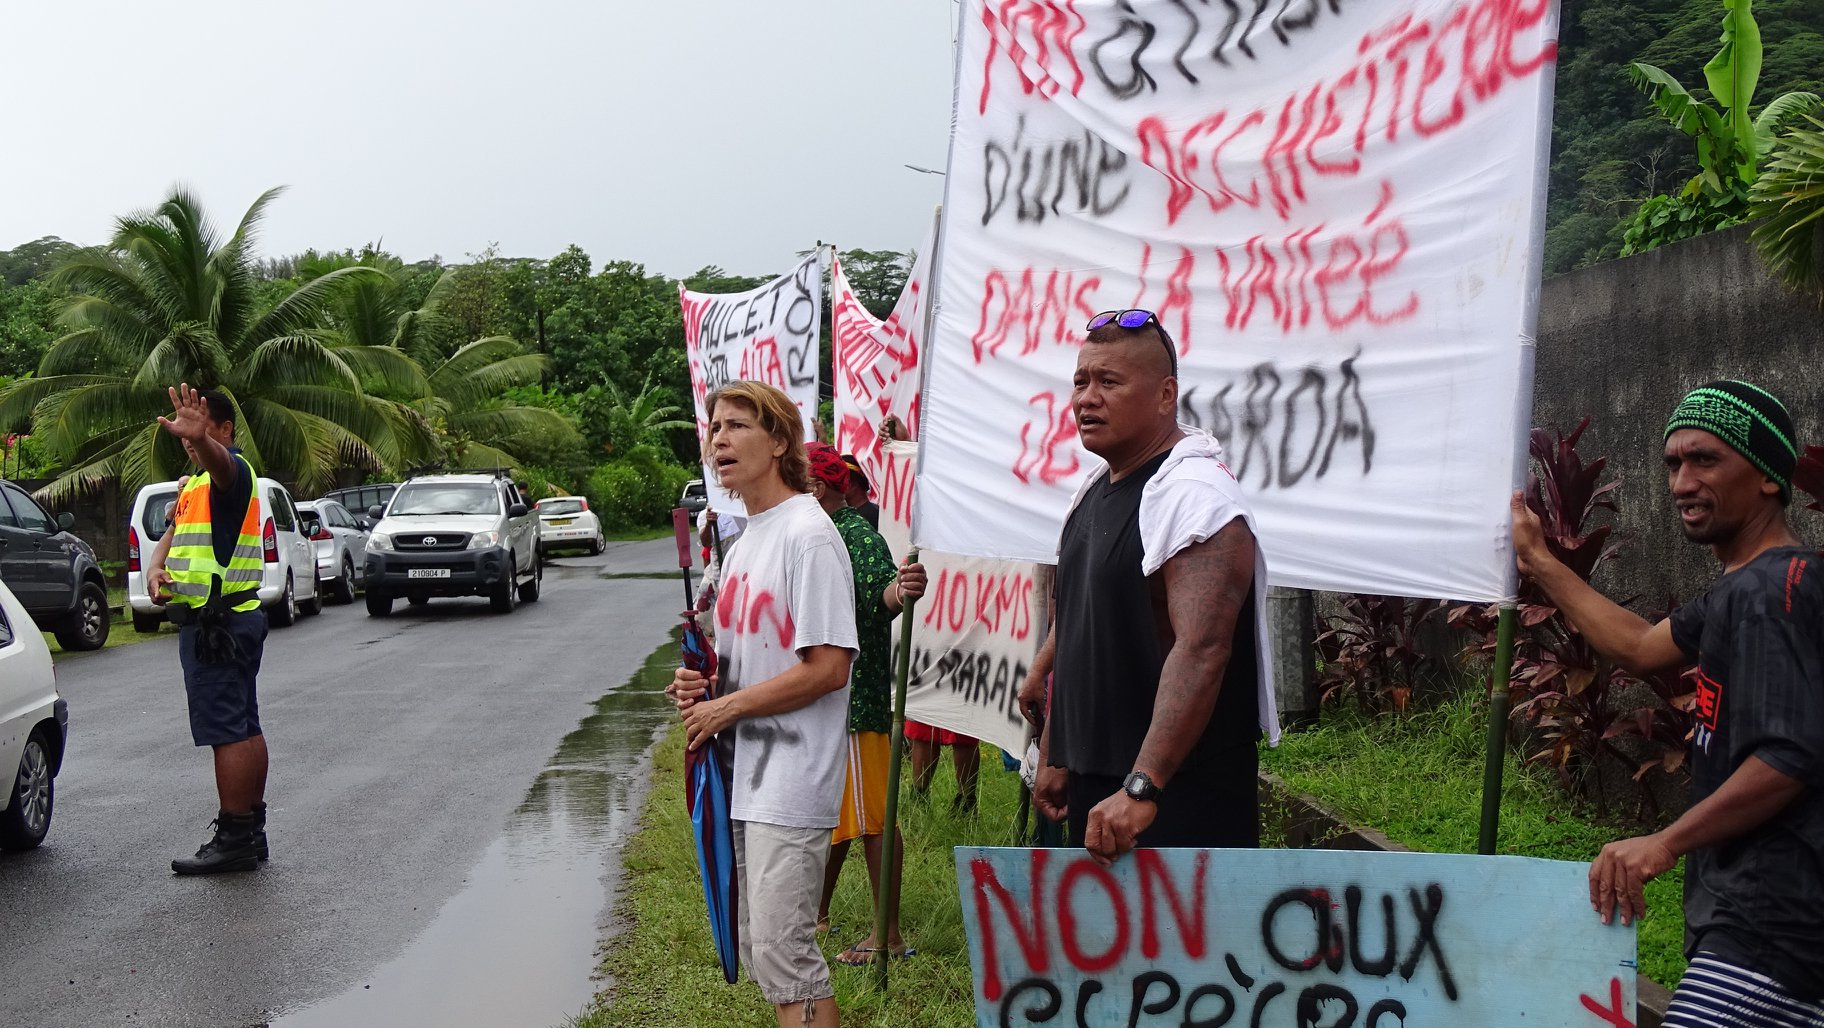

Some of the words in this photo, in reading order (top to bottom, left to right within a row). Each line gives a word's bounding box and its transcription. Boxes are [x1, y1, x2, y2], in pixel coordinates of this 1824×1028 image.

[971, 267, 1101, 364] DANS
[739, 336, 788, 392] AITA
[1177, 344, 1376, 490] AROA
[976, 571, 1034, 641] KMS
[935, 646, 1028, 729] MARAE
[971, 849, 1210, 1001] NON
